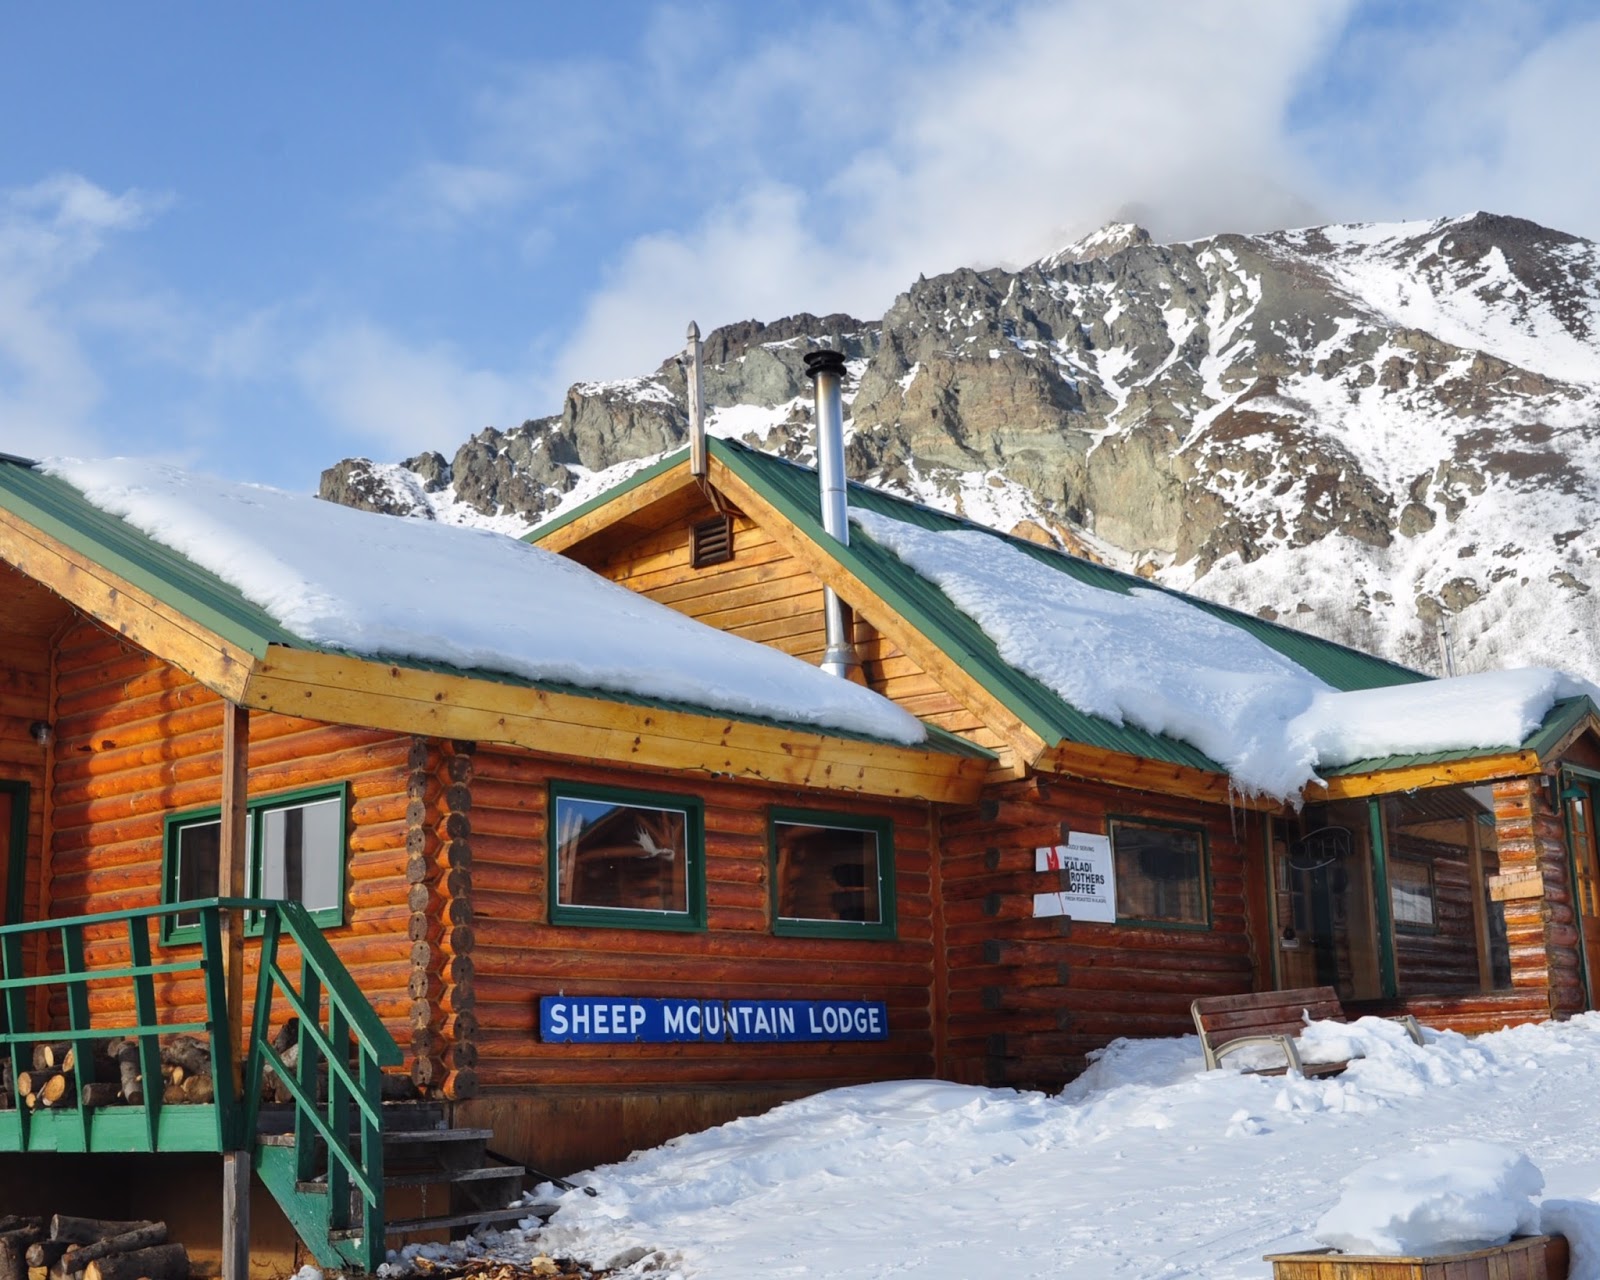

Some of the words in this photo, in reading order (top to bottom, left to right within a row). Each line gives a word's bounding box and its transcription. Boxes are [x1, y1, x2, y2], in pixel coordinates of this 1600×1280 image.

[1064, 861, 1092, 872] KALADI
[1070, 872, 1105, 885] ROTHERS
[1070, 883, 1096, 895] OFFEE
[550, 1003, 646, 1034] SHEEP
[663, 1005, 795, 1035] MOUNTAIN
[808, 1006, 881, 1034] LODGE
